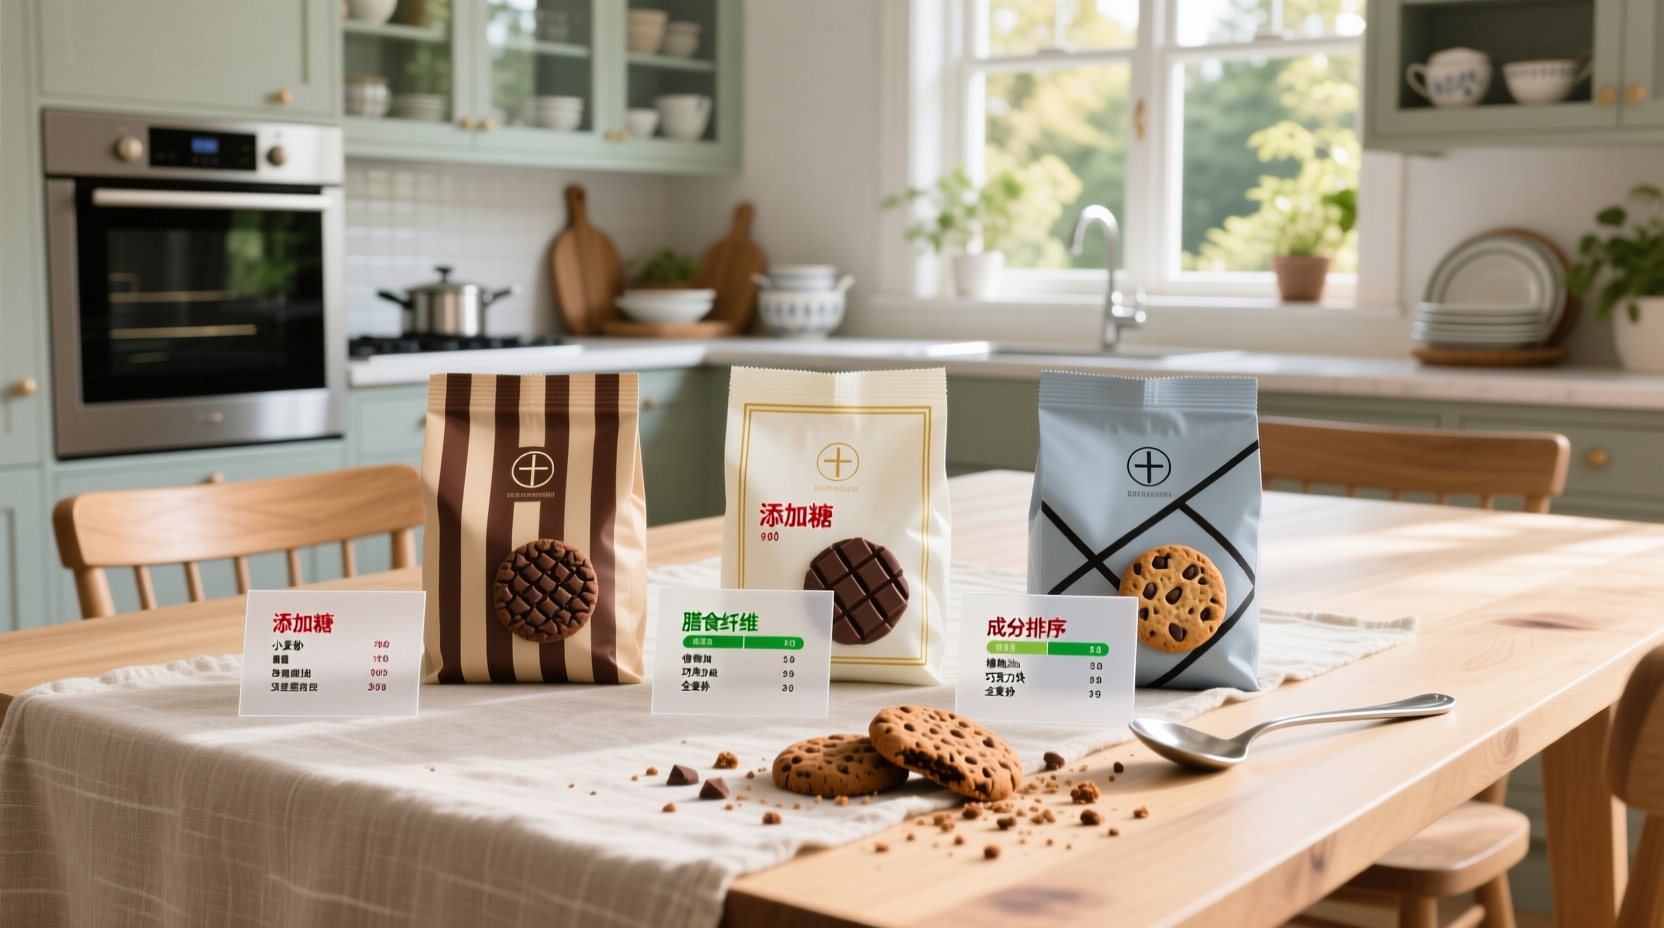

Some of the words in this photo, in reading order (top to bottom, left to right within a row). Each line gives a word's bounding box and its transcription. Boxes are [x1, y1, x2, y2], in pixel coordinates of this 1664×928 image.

[760, 502, 834, 529] 添加糖
[273, 613, 335, 634] 添加糖
[682, 611, 759, 632] 膳食纤维
[987, 616, 1067, 639] 成分排序
